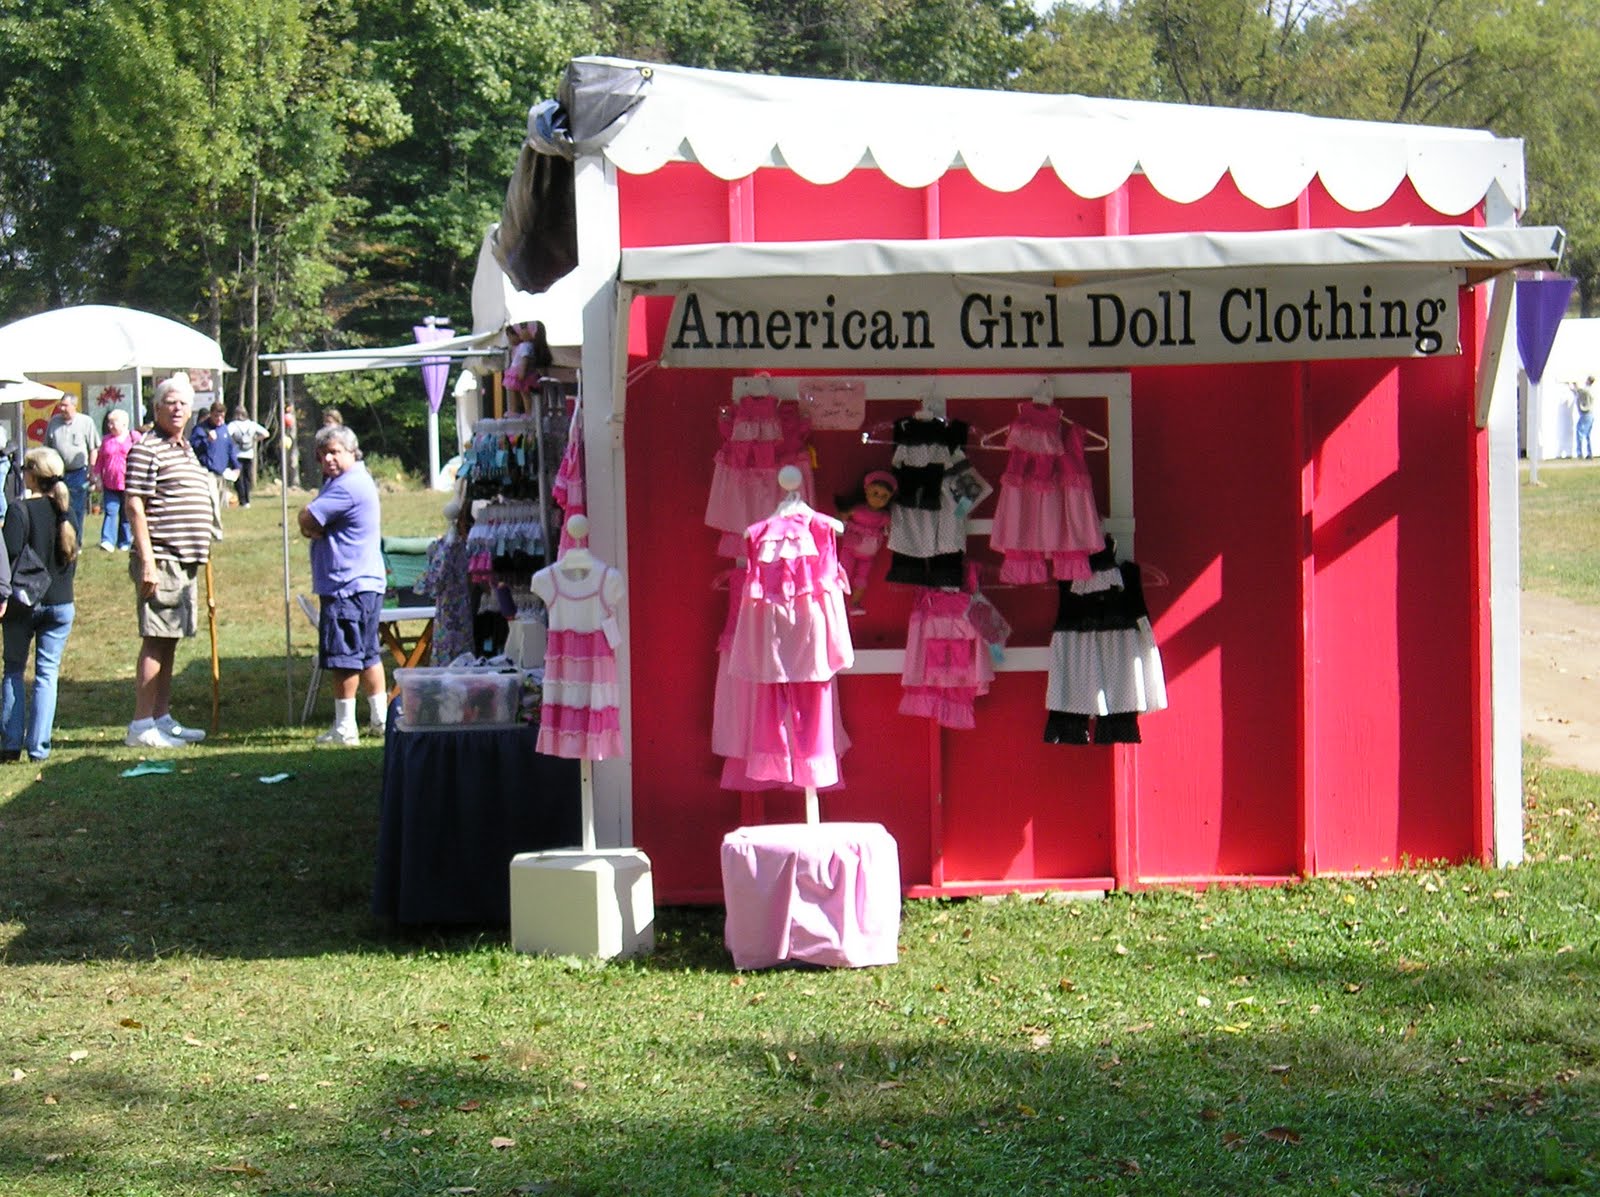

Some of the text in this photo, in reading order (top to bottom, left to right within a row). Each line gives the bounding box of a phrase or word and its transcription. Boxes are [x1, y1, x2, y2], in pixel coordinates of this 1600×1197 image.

[671, 285, 1447, 354] American Girl Doll Clothing
